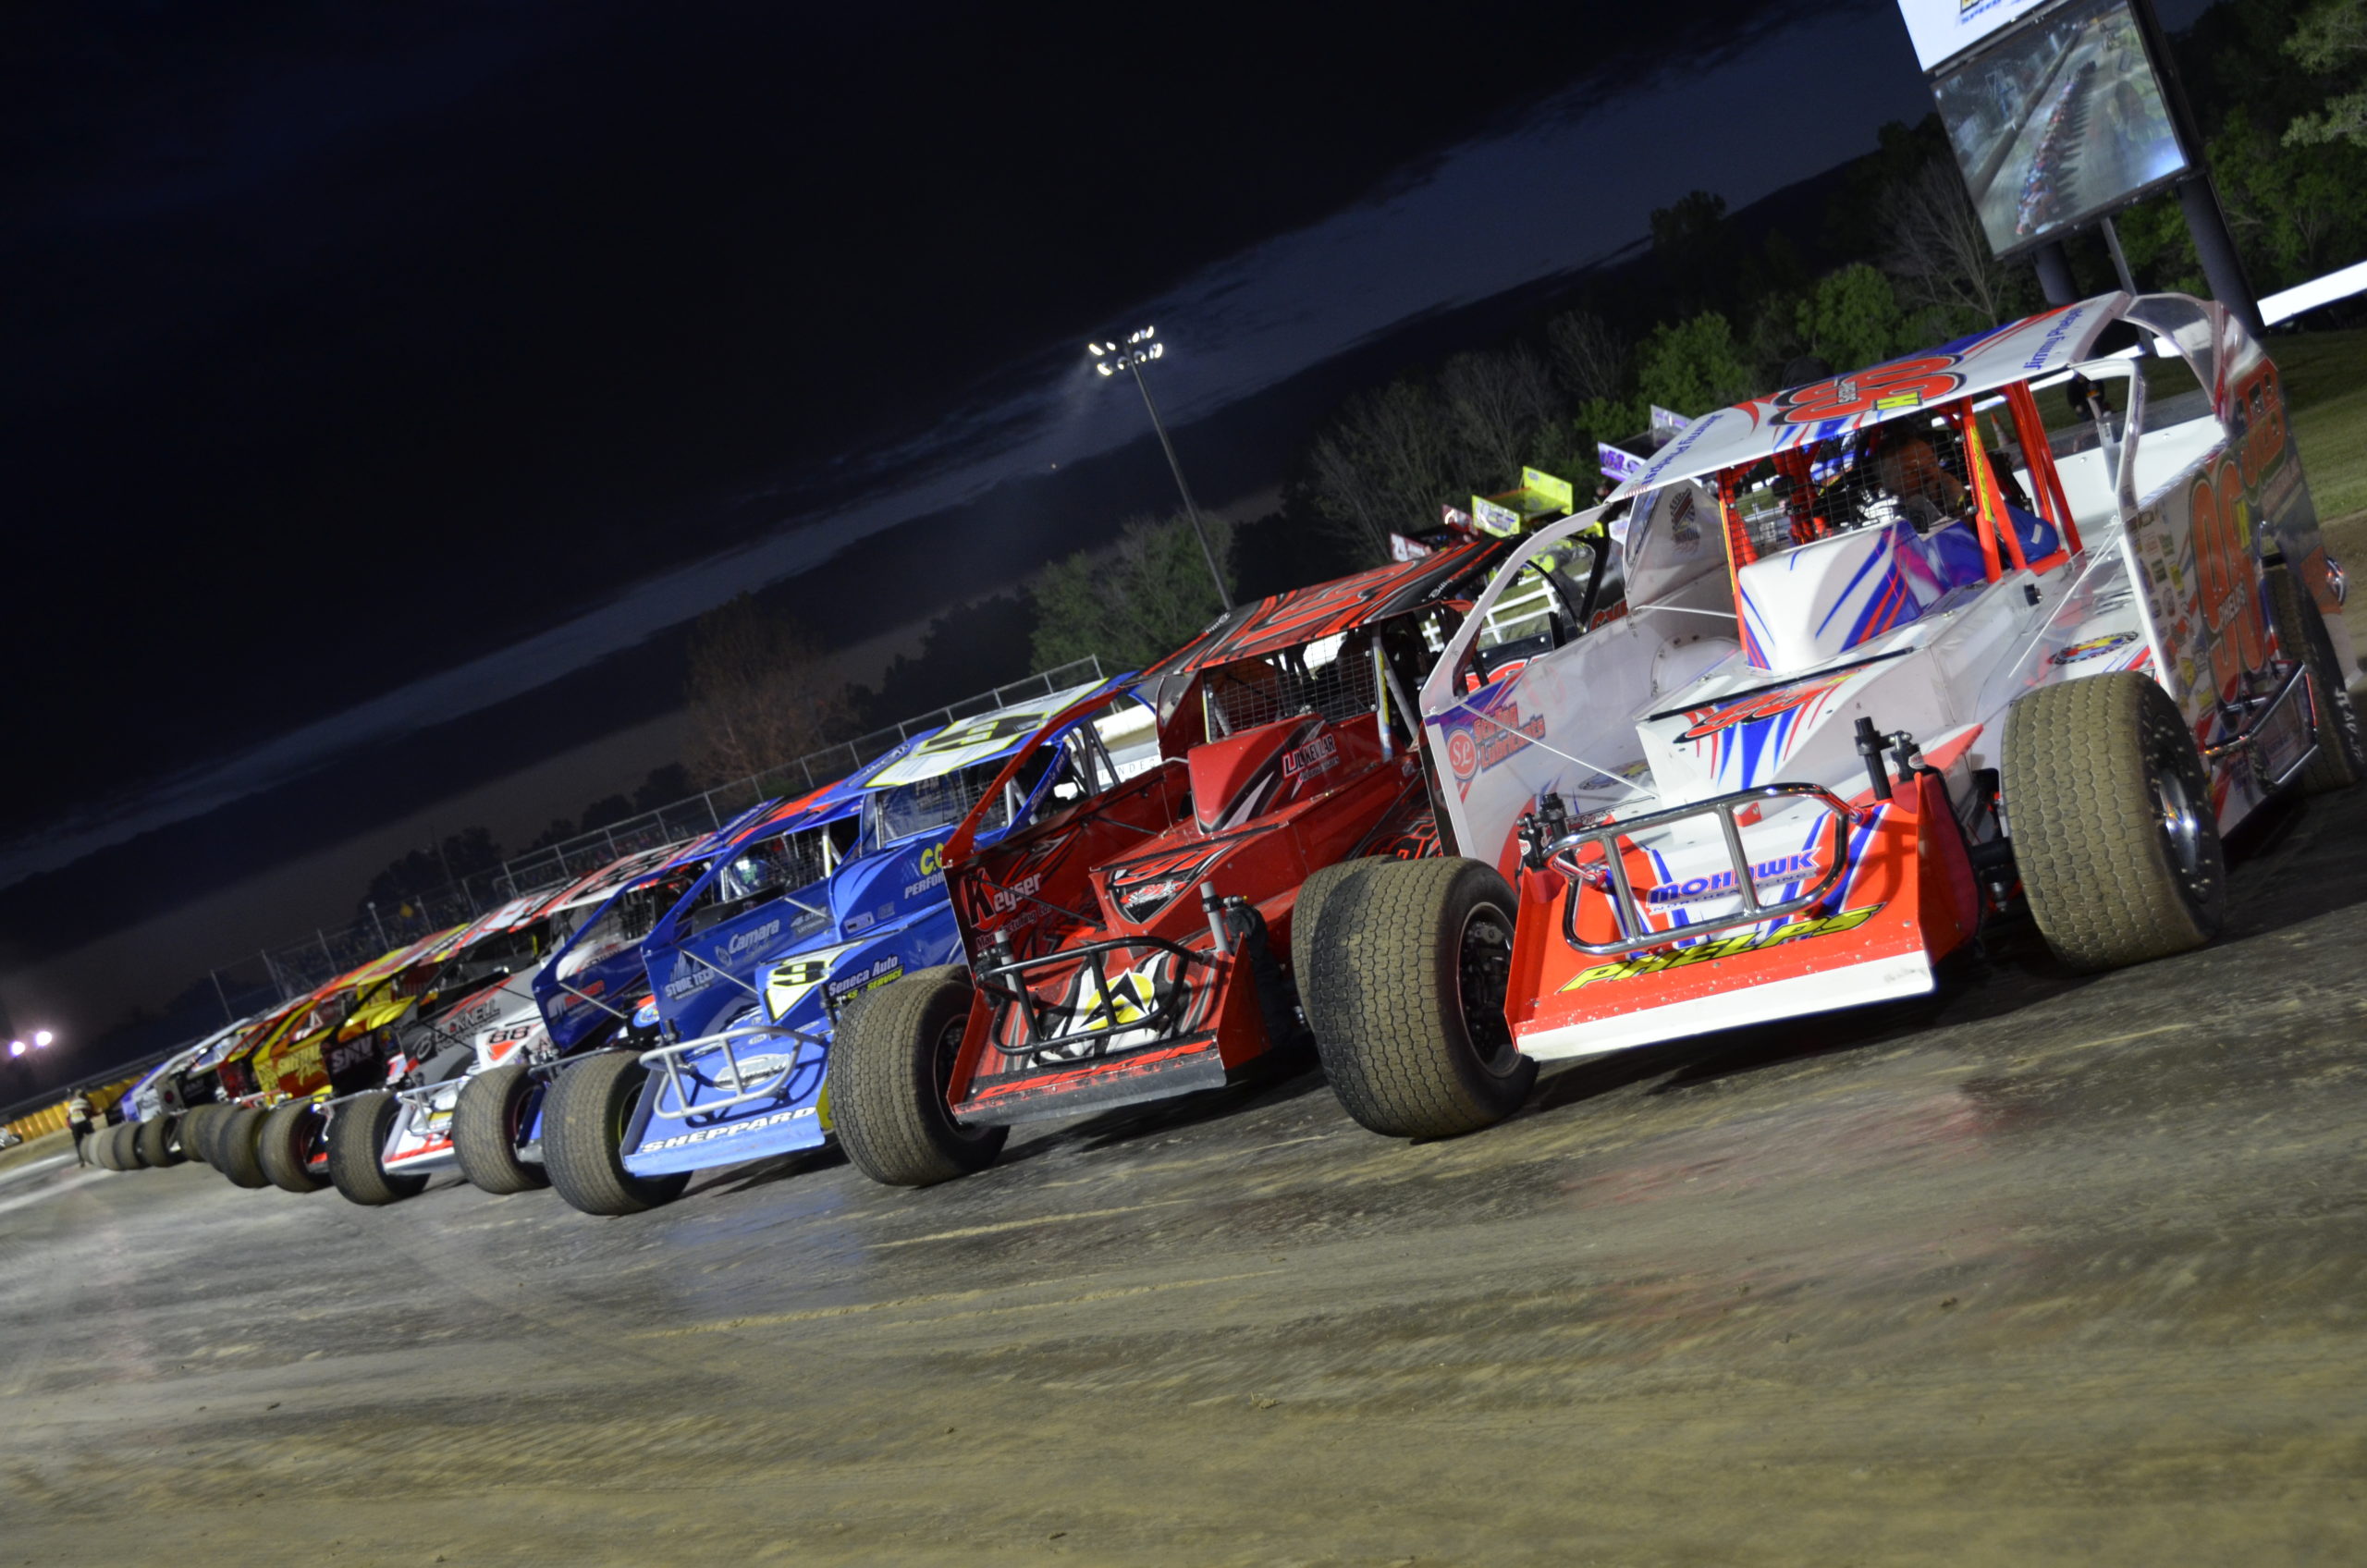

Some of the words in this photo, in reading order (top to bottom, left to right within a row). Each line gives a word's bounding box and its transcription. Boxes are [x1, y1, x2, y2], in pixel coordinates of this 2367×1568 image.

[1452, 741, 1472, 767] SL
[962, 866, 1041, 928] Keyser
[728, 918, 780, 954] Camara
[975, 910, 1036, 949] Manacturing
[1557, 902, 1886, 994] PHELPS
[828, 968, 870, 997] Seneca
[872, 955, 900, 976] Auto
[489, 1025, 531, 1044] 88
[642, 1107, 817, 1153] SHEPPARD
